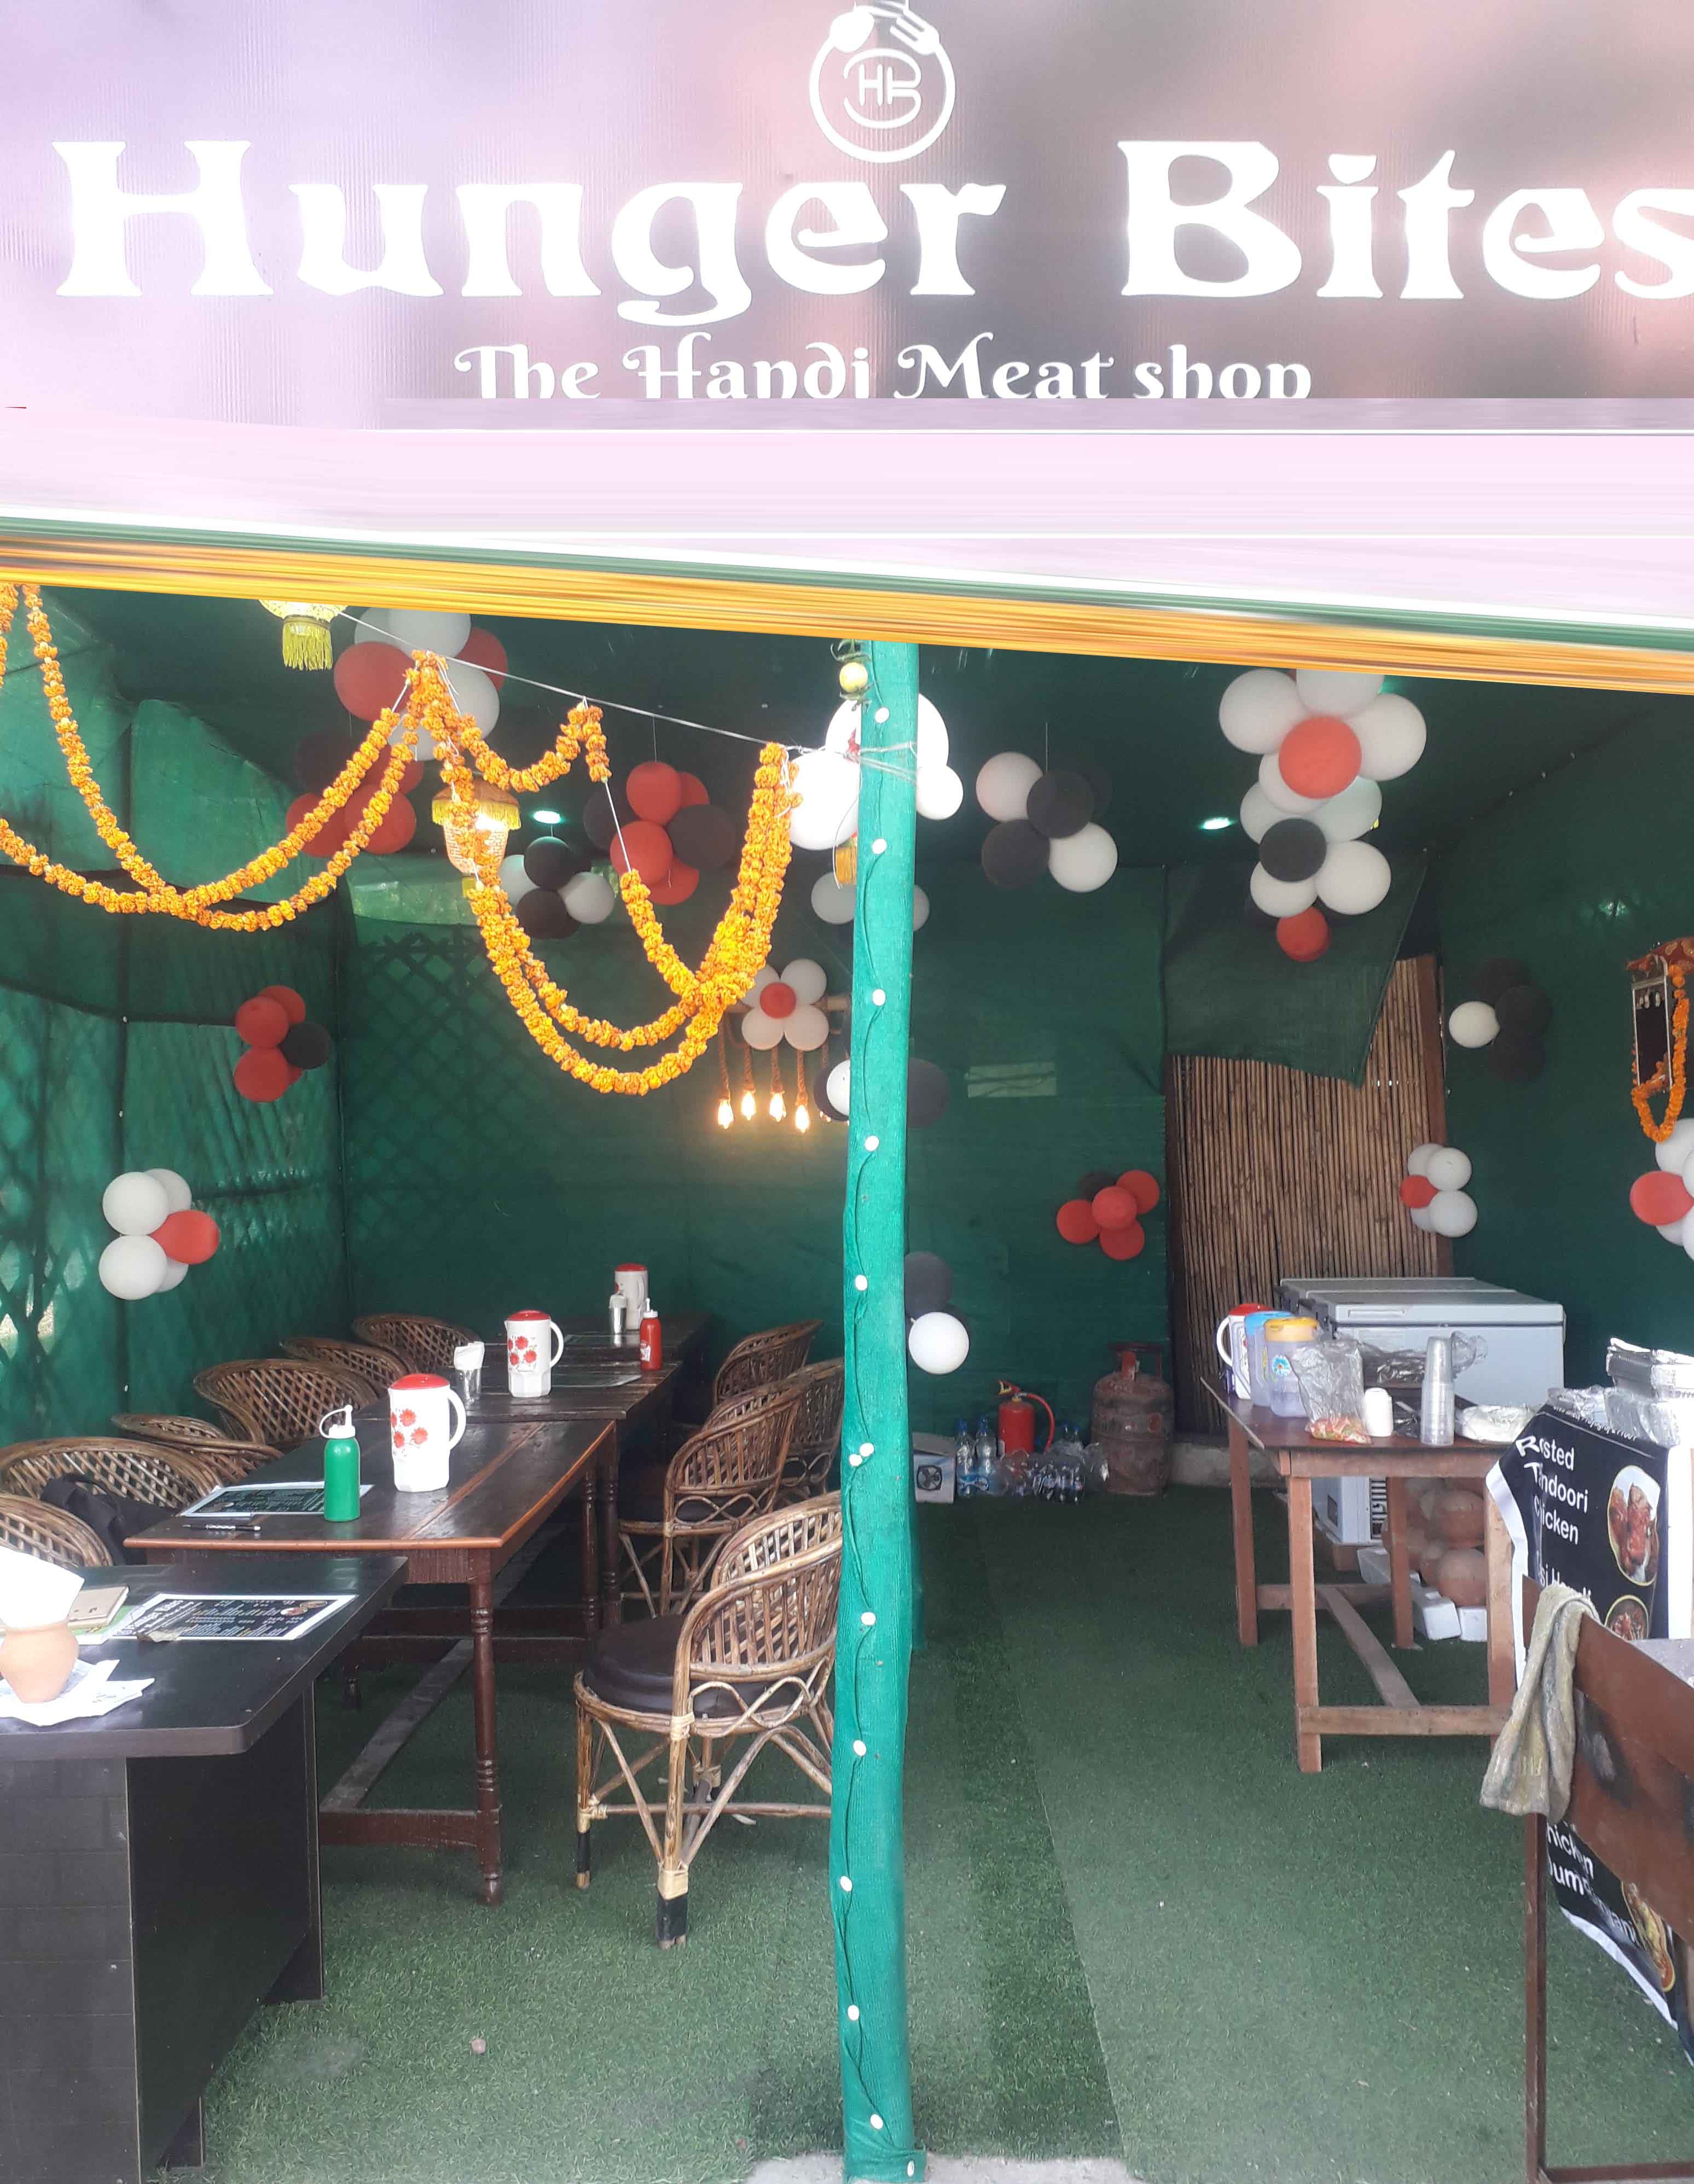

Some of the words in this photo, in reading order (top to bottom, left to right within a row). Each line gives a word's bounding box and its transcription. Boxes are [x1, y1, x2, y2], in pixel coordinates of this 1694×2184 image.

[52, 140, 1006, 327] Hunger
[1117, 140, 1694, 300] Bites
[454, 344, 601, 399] The
[622, 332, 872, 399] Handi
[893, 332, 1115, 399] Meat
